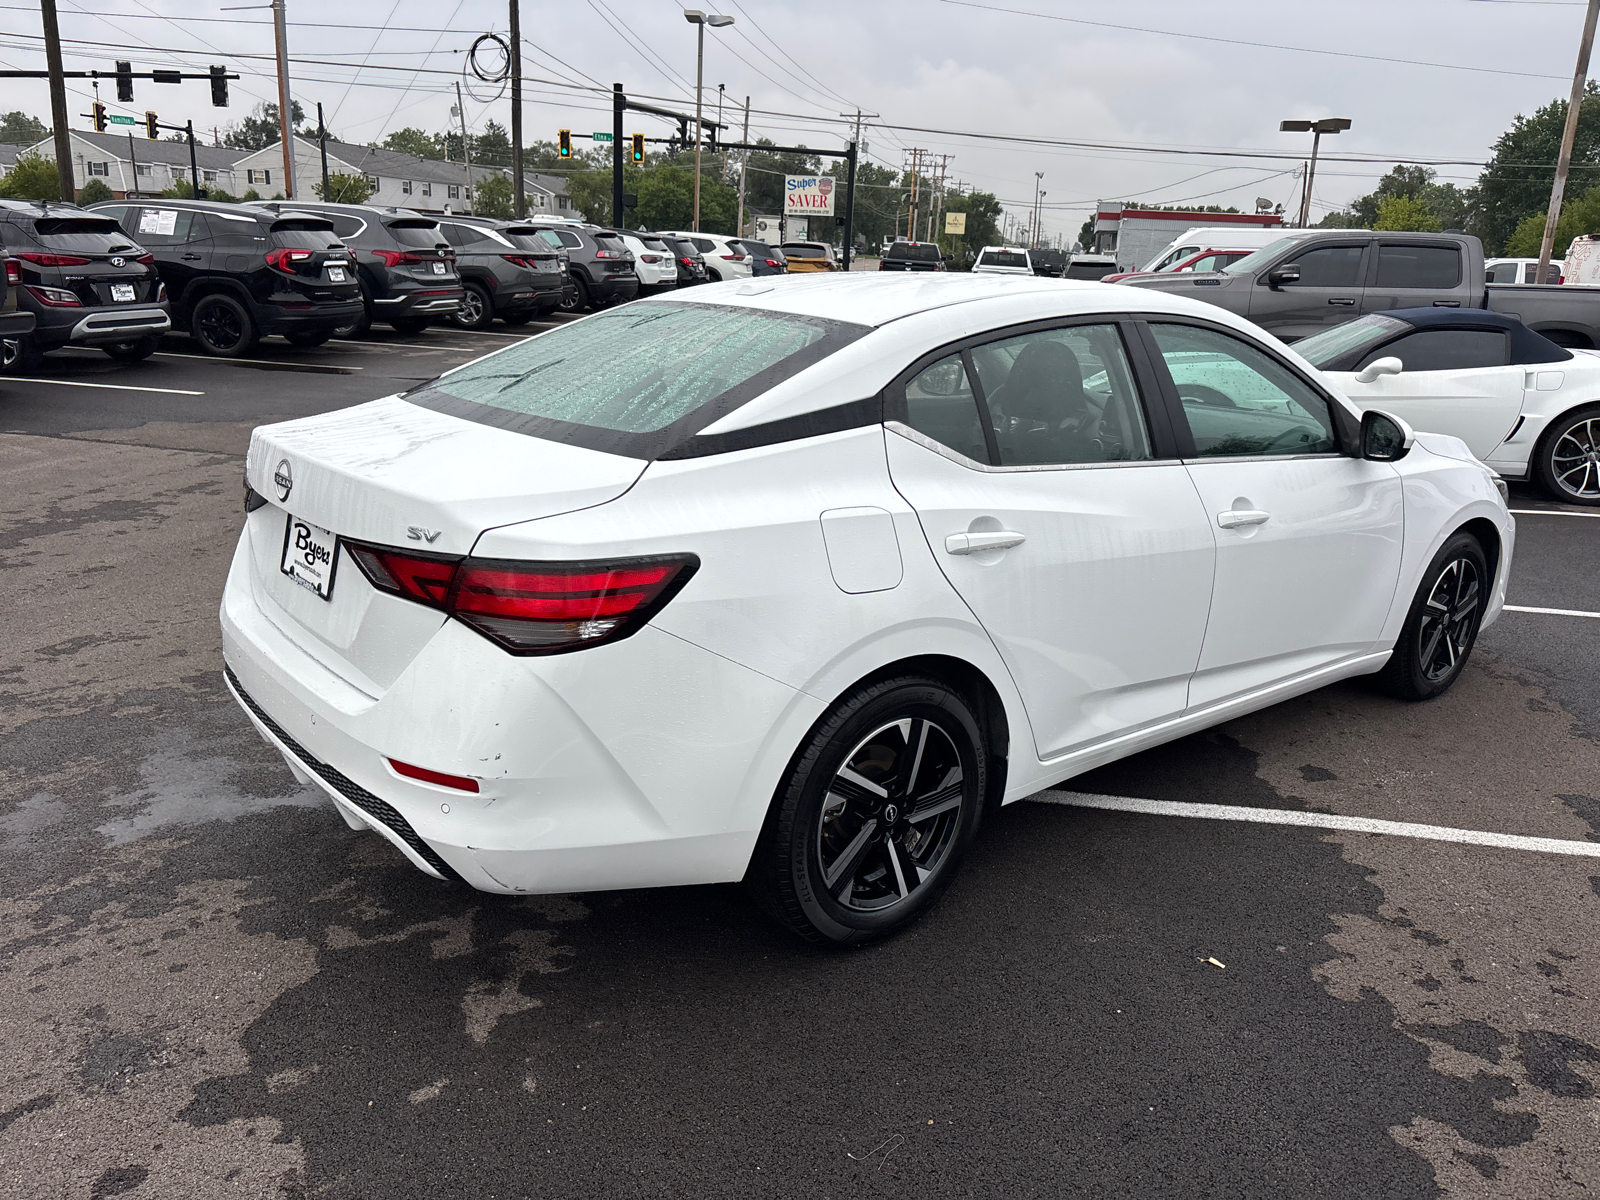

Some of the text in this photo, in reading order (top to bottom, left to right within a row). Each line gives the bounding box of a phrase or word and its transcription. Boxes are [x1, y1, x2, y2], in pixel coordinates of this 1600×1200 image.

[787, 178, 817, 191] Super
[788, 194, 828, 208] SAVER
[294, 522, 330, 566] Byers
[406, 525, 442, 544] SV
[796, 832, 813, 903] ALL-SEASON
